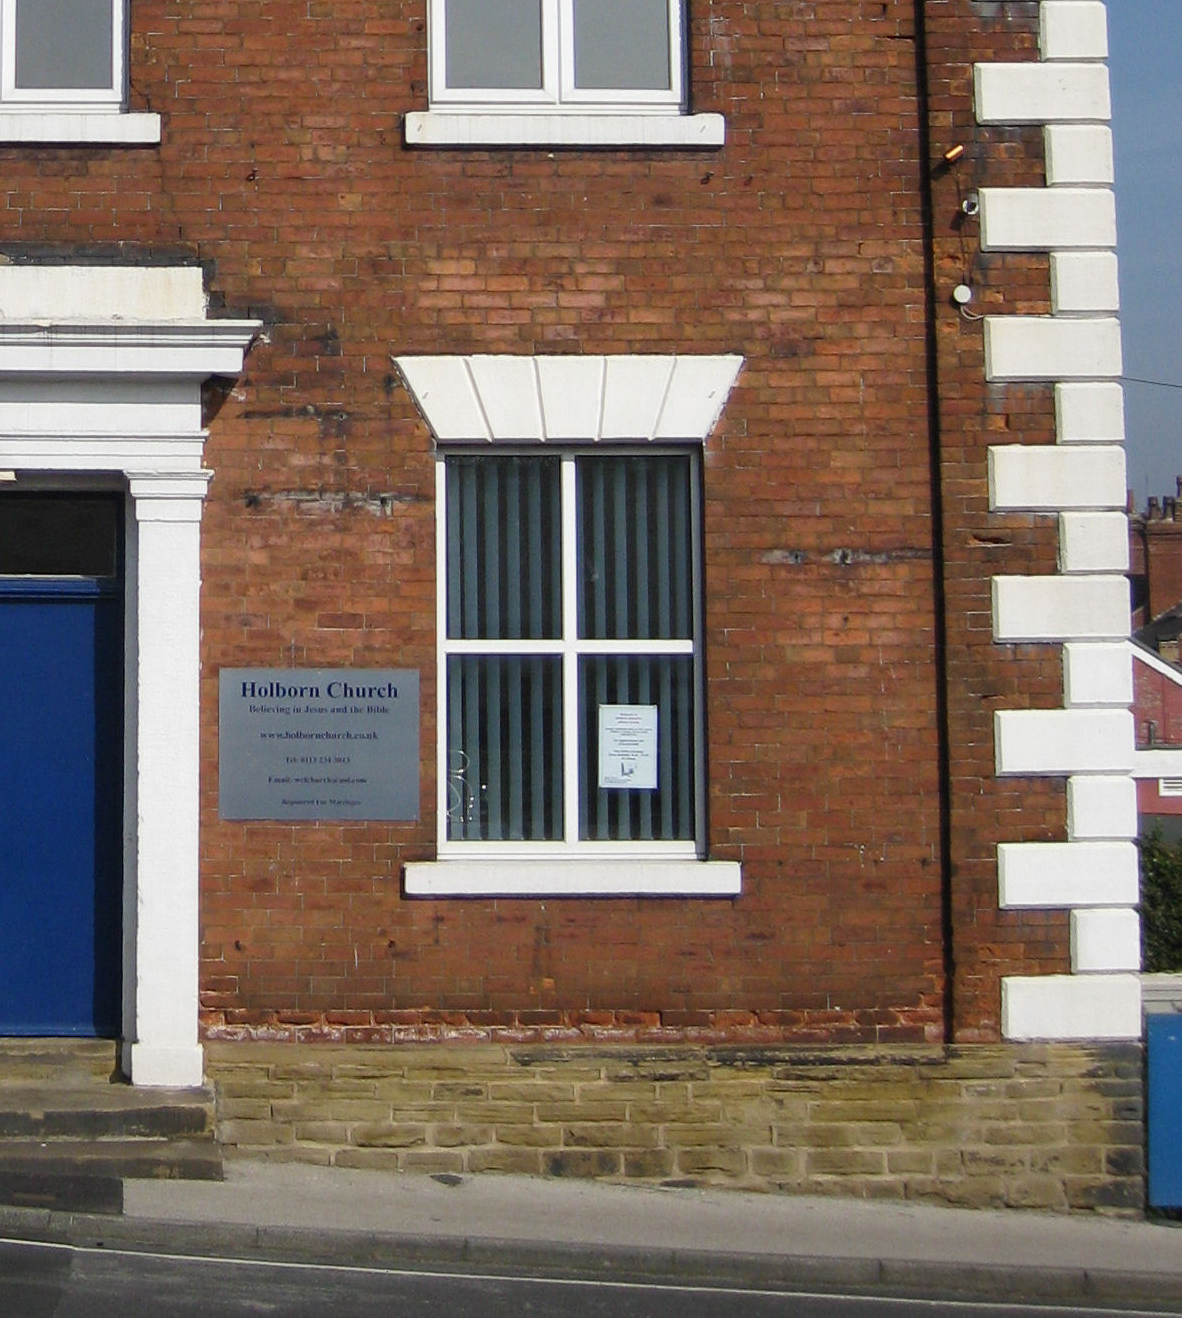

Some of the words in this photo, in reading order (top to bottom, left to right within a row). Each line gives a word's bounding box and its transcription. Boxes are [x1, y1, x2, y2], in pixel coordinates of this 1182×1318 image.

[241, 681, 320, 699] Holborn
[327, 681, 398, 699] Church
[249, 705, 290, 715] Believing
[293, 705, 302, 714] in
[304, 705, 329, 714] Jesus
[330, 705, 347, 714] and
[350, 705, 364, 714] the
[367, 705, 389, 714] Bible
[260, 731, 379, 740] www.holbornchurch.co.uk
